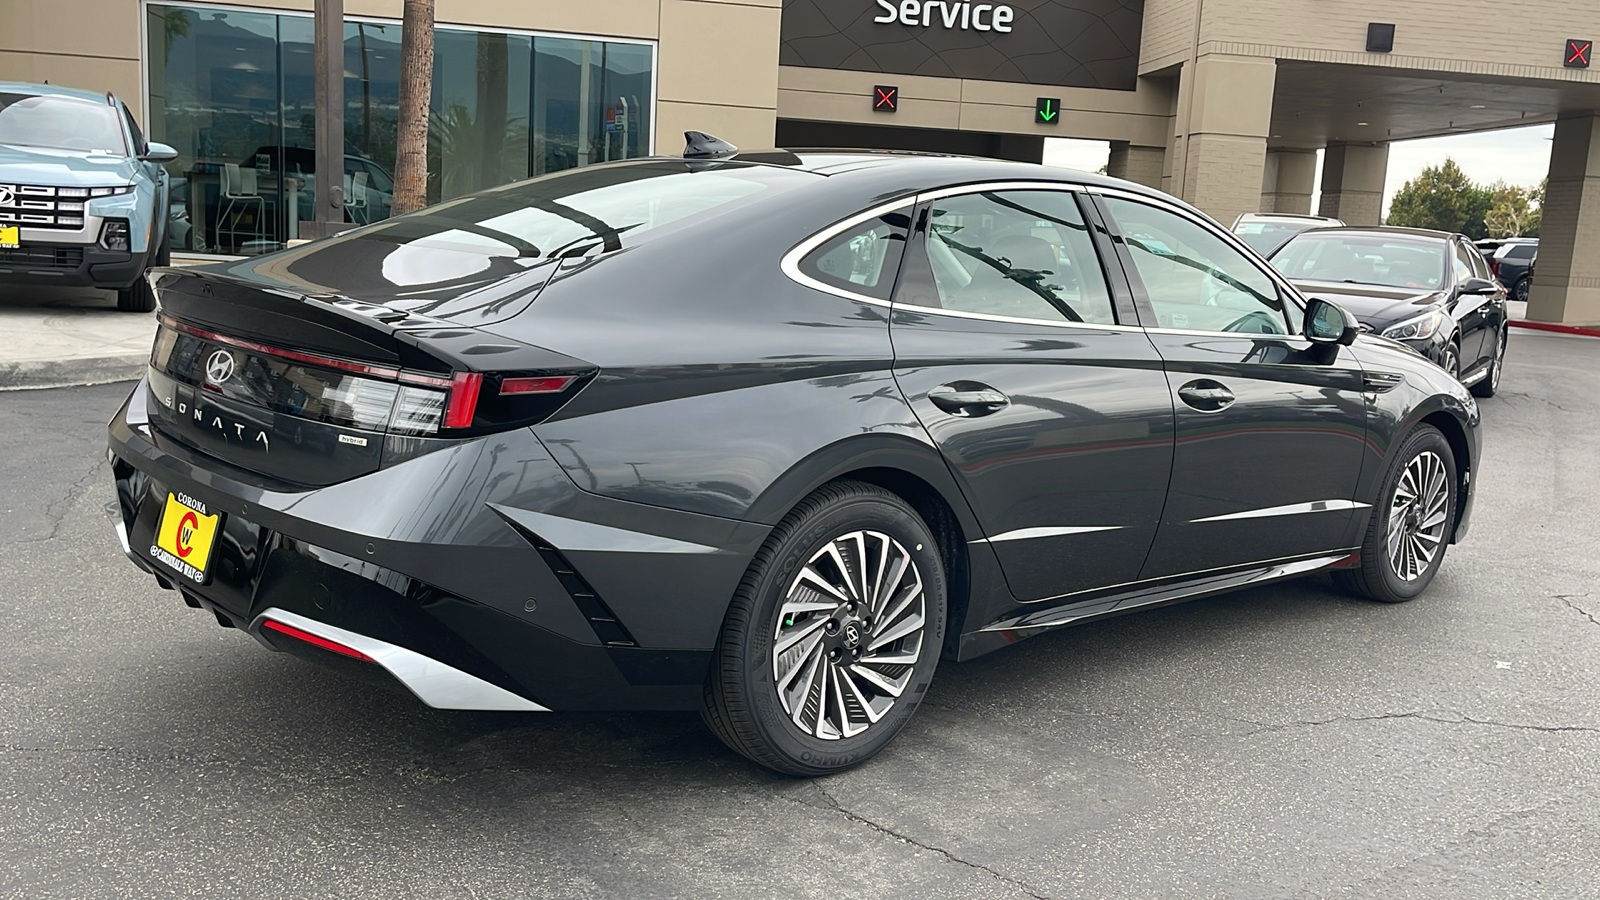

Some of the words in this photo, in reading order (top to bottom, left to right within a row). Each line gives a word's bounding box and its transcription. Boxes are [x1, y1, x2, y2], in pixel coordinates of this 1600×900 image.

[874, 0, 1014, 33] Service
[165, 397, 268, 444] SONATA
[342, 436, 363, 444] hybrid
[178, 492, 206, 514] CORONA
[182, 526, 193, 546] W
[776, 524, 823, 588] SOLUS
